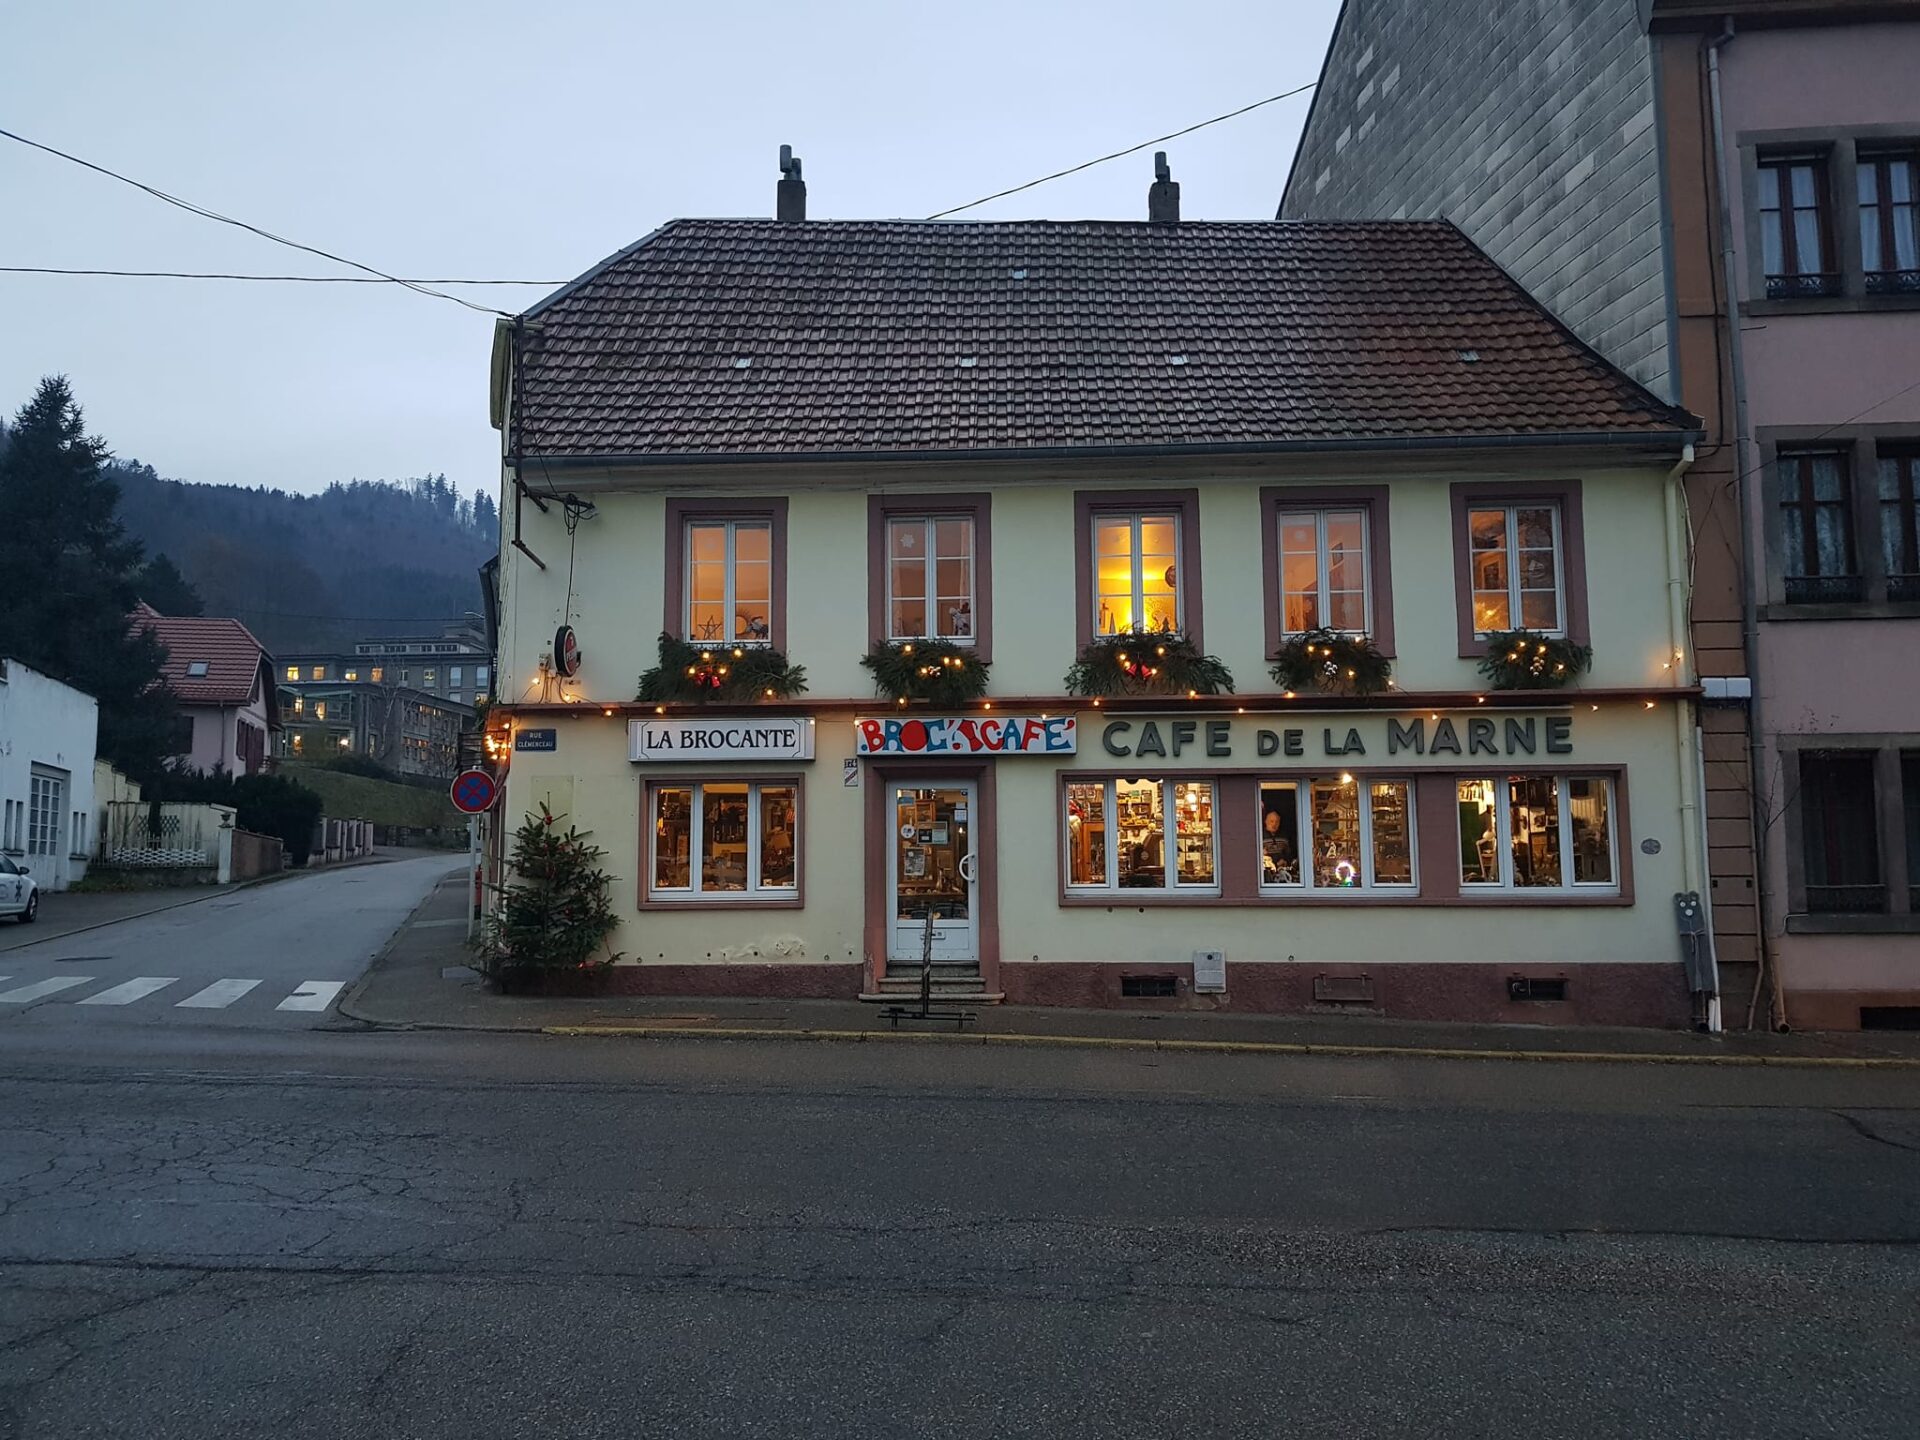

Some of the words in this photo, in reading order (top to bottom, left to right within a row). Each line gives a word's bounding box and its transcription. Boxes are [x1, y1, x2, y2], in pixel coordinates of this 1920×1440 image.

[646, 730, 674, 750] LA
[679, 729, 797, 749] BROCANTE
[1102, 720, 1232, 757] CAFE
[1257, 729, 1304, 756] DE
[1324, 728, 1366, 755] LA
[1387, 716, 1573, 755] MARNE
